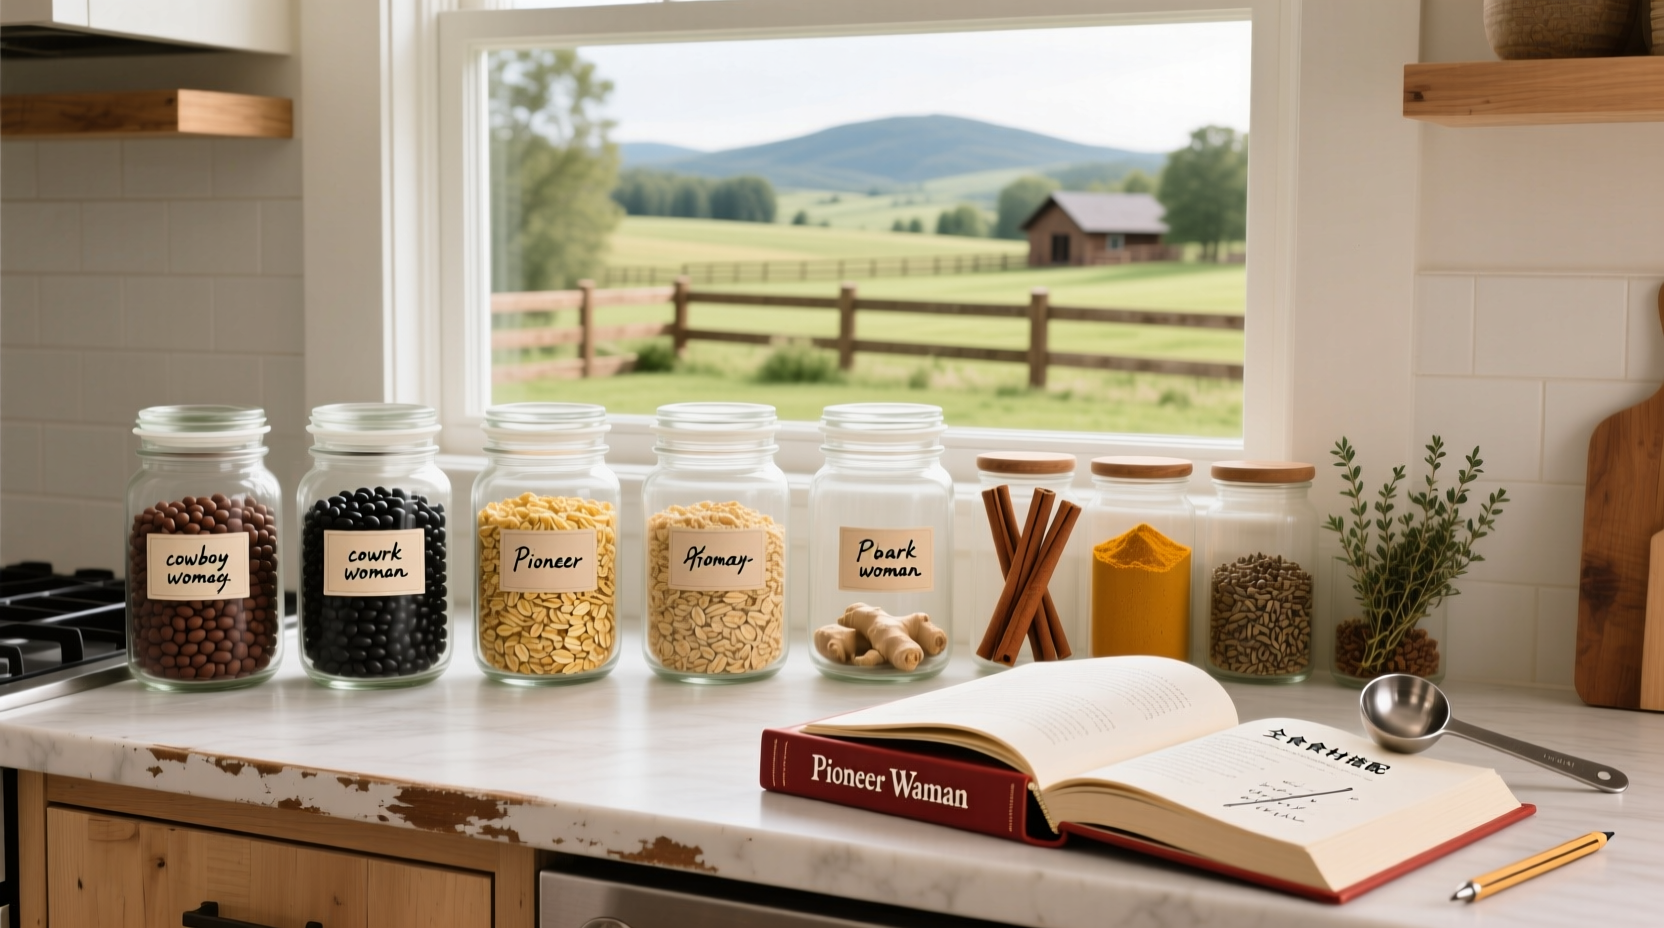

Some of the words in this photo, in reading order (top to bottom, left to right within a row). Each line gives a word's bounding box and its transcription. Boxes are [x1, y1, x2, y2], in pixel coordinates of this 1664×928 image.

[166, 544, 229, 572] cowboy
[348, 541, 402, 563] cowrk
[513, 546, 583, 573] Pioneer
[344, 565, 409, 581] woman
[859, 565, 922, 578] woman
[811, 754, 886, 793] Pioneer
[889, 768, 969, 809] Waman
